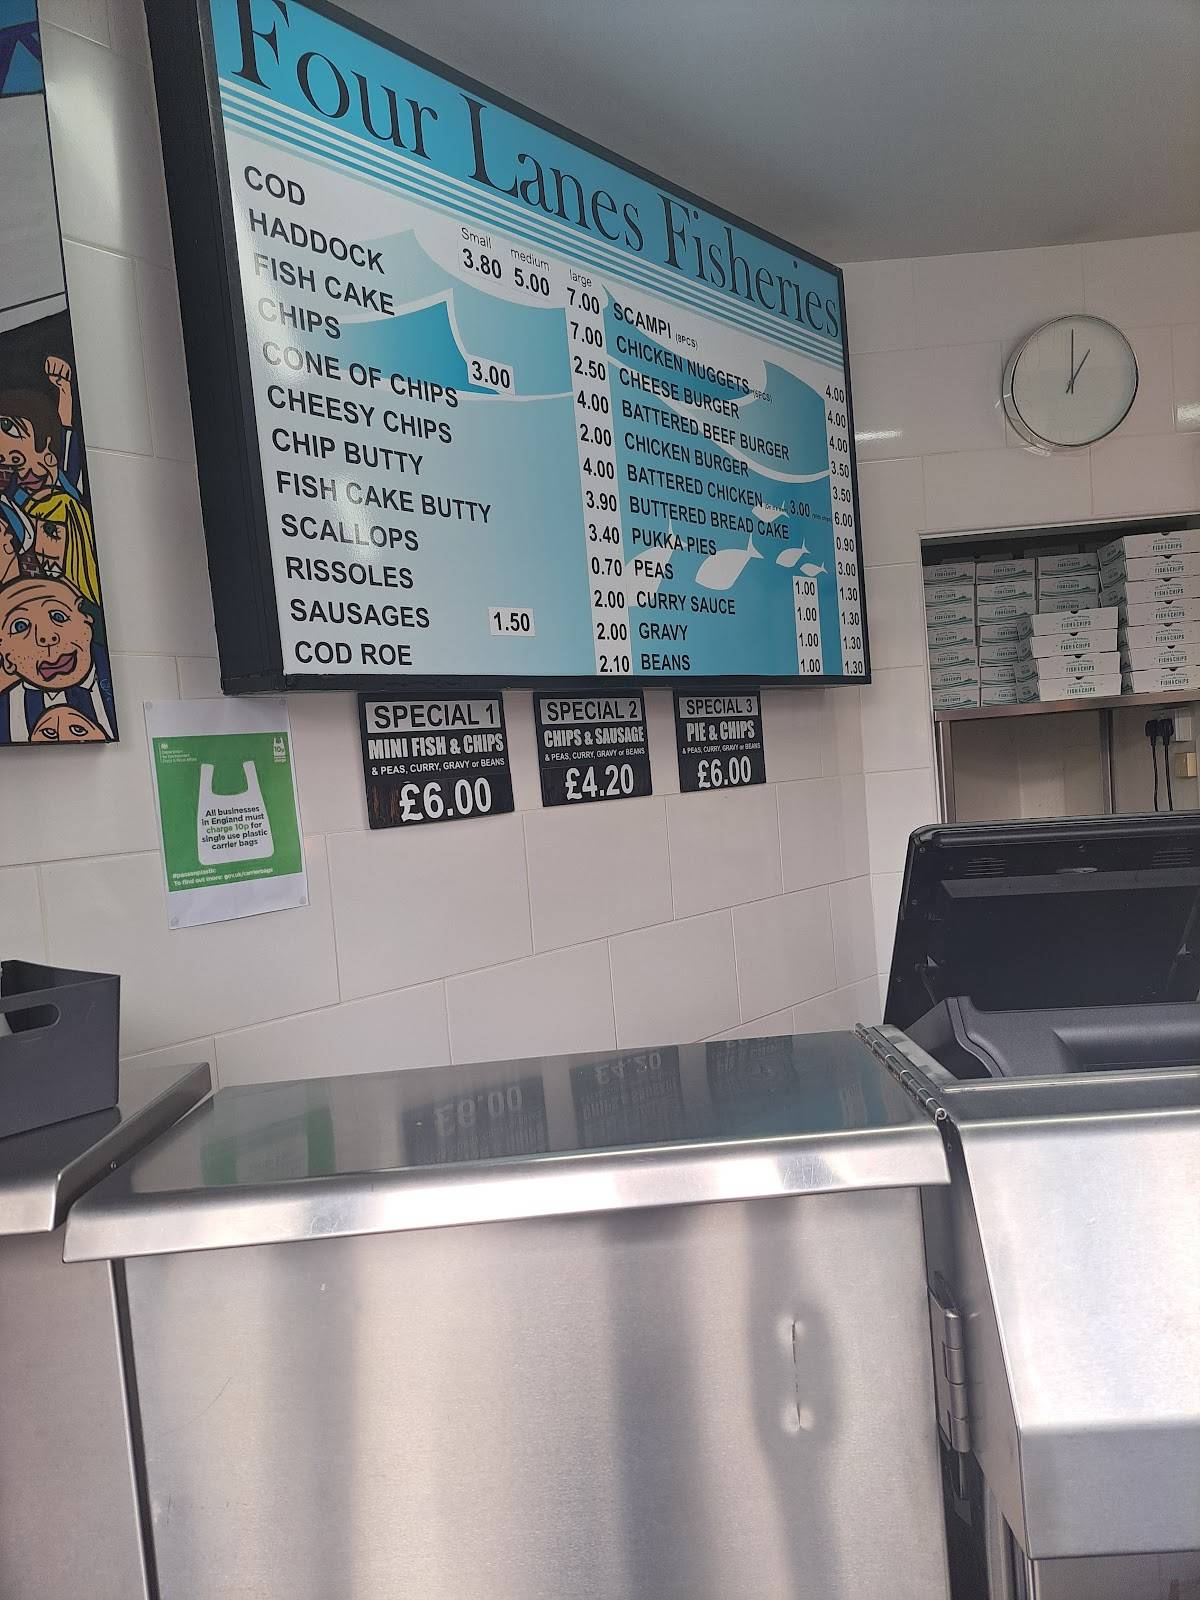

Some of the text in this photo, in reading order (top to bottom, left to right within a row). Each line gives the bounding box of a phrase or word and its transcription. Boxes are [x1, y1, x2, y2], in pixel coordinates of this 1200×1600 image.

[231, 0, 840, 339] Four Lanes Fisheries
[244, 165, 306, 206] COD
[249, 208, 385, 275] HADDOCK
[461, 227, 492, 250] Small
[510, 247, 550, 272] medium
[253, 252, 395, 316] FISH CAKE
[462, 248, 600, 315] 3.80 5.00 7.00
[569, 268, 593, 288] large
[257, 297, 341, 340] CHIPS
[613, 302, 672, 339] SCAMPI
[570, 321, 603, 348] 7.00
[262, 341, 459, 408] CONE OF CHIPS
[573, 355, 606, 382] 2.50
[616, 335, 683, 373] CHICKEN
[687, 358, 750, 395] NUGGETS
[471, 360, 609, 415] 3.00 4.00
[619, 367, 740, 420] CHEESE BURGER
[825, 384, 845, 404] 4.00
[267, 384, 452, 444] CHEESY CHIPS
[827, 409, 847, 429] 4.00
[579, 423, 613, 447] 2.00
[622, 399, 790, 461] BATTERED BEEF BURGER
[272, 427, 424, 476] CHIP BUTTY
[624, 432, 750, 478] CHICKEN BURGER
[829, 435, 848, 454] 4.00
[583, 457, 615, 480] 4.00
[831, 460, 850, 479] 3.50
[627, 463, 763, 508] BATTERED CHICKEN
[832, 486, 851, 503] 3.50
[276, 470, 491, 524] FISH CAKE BUTTY
[585, 490, 617, 513] 3.90
[629, 495, 790, 540] BUTTERED BREAD CAKE
[790, 499, 811, 518] 3.00
[834, 511, 853, 528] 6.00
[281, 513, 420, 552] SCALLOPS
[588, 523, 620, 545] 3.40
[632, 527, 717, 556] PUKKA PIES
[836, 536, 855, 552] 0.90
[285, 555, 414, 589] RISSOLES
[591, 556, 622, 577] 0.70
[634, 559, 674, 580] PEAS
[838, 561, 856, 577] 3.00
[594, 589, 625, 608] 2.00
[795, 581, 816, 596] 1.00
[840, 587, 858, 602] 1.30
[290, 598, 430, 629] SAUSAGES
[636, 590, 736, 615] CURRY SAUCE
[493, 611, 530, 632] 1.50
[797, 606, 817, 622] 1.00
[841, 612, 860, 626] 1.30
[596, 622, 628, 641] 2.00
[639, 622, 688, 641] GRAVY
[799, 631, 819, 647] 1.00
[295, 640, 413, 666] COD ROE
[843, 636, 862, 651] 1.30
[599, 655, 630, 673] 2.10
[641, 653, 691, 671] BEANS
[800, 658, 821, 674] 1.00
[844, 660, 864, 675] 1.30
[374, 703, 494, 729] SPECIAL 1
[546, 700, 638, 722] SPECIAL 2
[686, 698, 753, 715] SPECIAL 3
[544, 726, 645, 748] CHIPS & SAUSAGE
[686, 720, 755, 742] PIE & CHIPS
[368, 732, 504, 760] MINI FISH & CHIPS
[545, 753, 550, 762] &
[551, 752, 571, 761] PEAS,
[572, 750, 596, 760] CURRY,
[597, 748, 617, 758] GRAVY
[625, 747, 646, 756] BEANS
[371, 757, 505, 776] & PEAS, CURRY, GRAVY or BEANS
[697, 755, 752, 789] £6.00
[565, 763, 634, 801] £4.20
[399, 777, 492, 823] £6.00
[205, 806, 260, 817] All businesses
[211, 814, 243, 825] England
[245, 813, 265, 821] must
[201, 833, 226, 843] single
[242, 829, 268, 840] plastic
[234, 823, 250, 832] 10p
[211, 839, 259, 850] carrier bags
